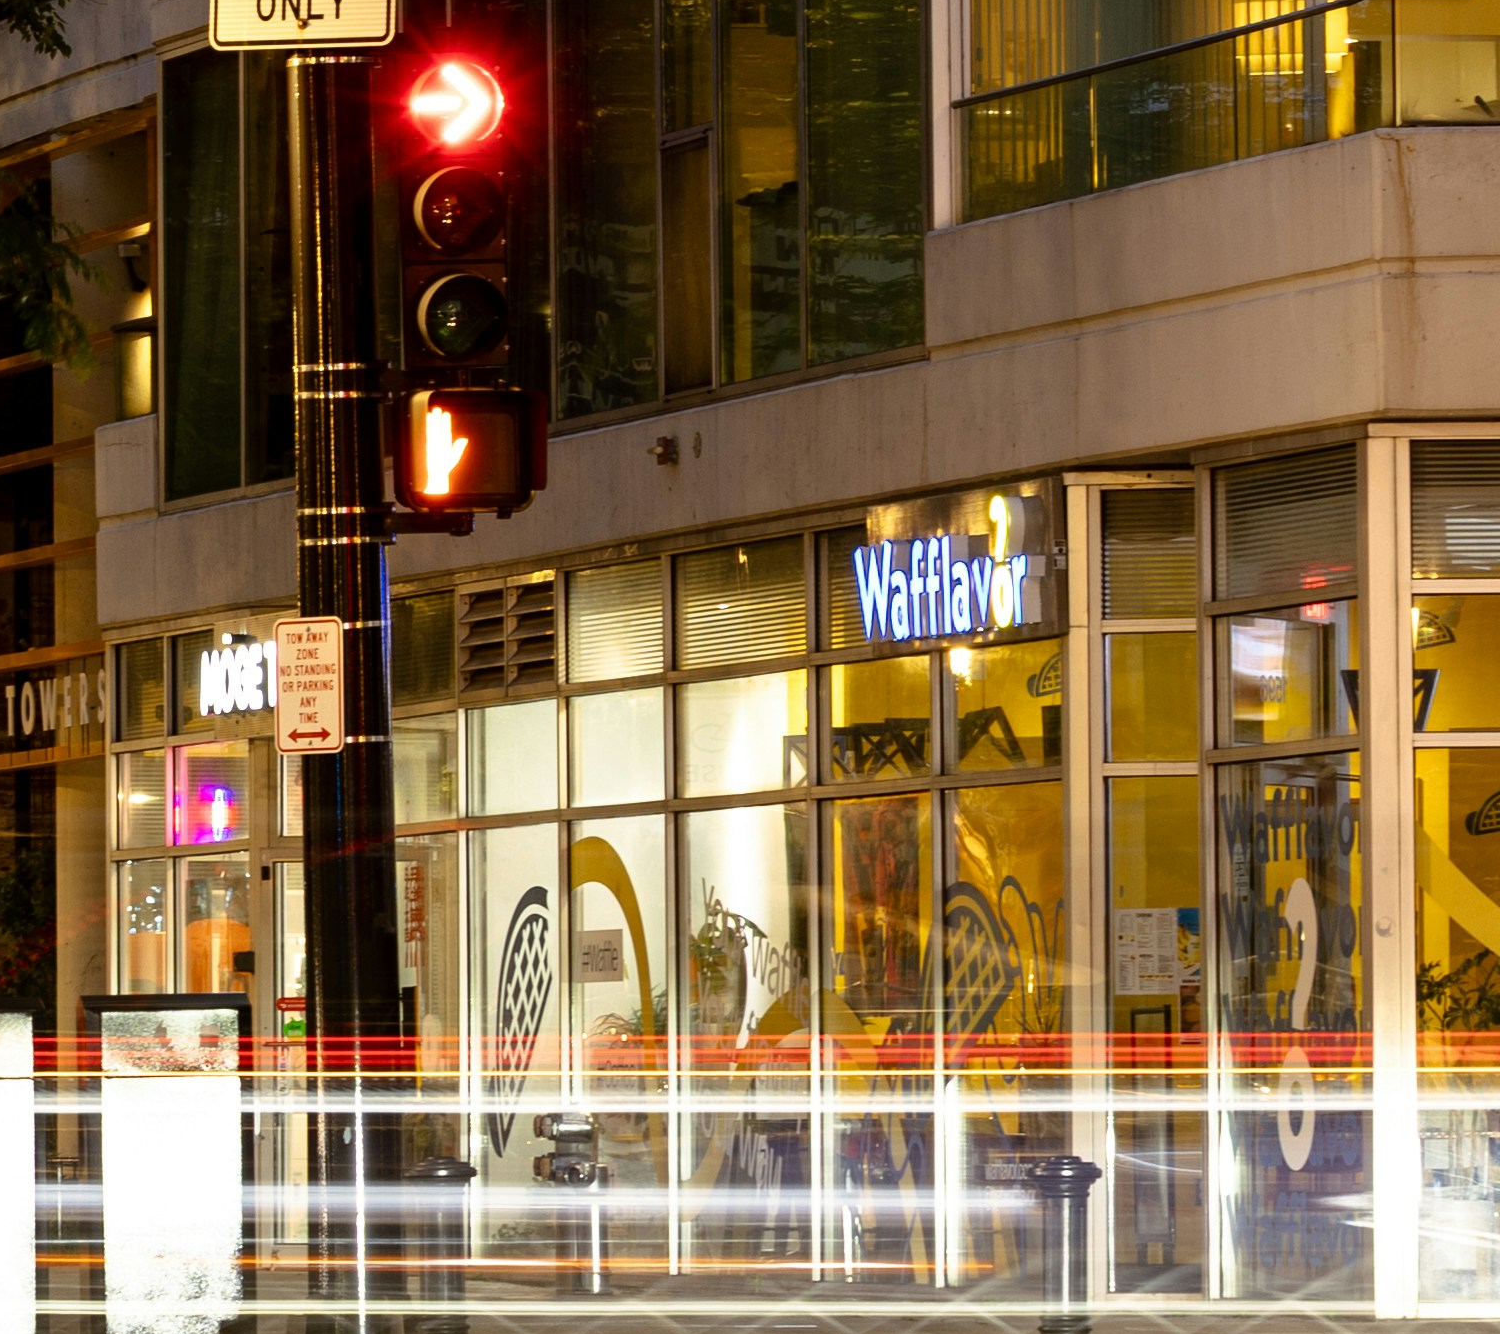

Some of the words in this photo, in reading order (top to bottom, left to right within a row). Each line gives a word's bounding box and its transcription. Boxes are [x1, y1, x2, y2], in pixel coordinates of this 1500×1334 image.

[853, 529, 1028, 643] Wafflavor
[285, 633, 303, 645] TOW
[306, 631, 329, 644] AWAY
[296, 648, 320, 660] ZONE
[280, 665, 292, 677] NO
[295, 663, 337, 676] STANDING
[282, 681, 294, 693] OR
[296, 679, 335, 692] PARKING
[5, 668, 106, 737] TOWERS
[300, 696, 318, 708] ANY
[299, 711, 319, 724] TIME
[1221, 786, 1362, 864] Wafflavo
